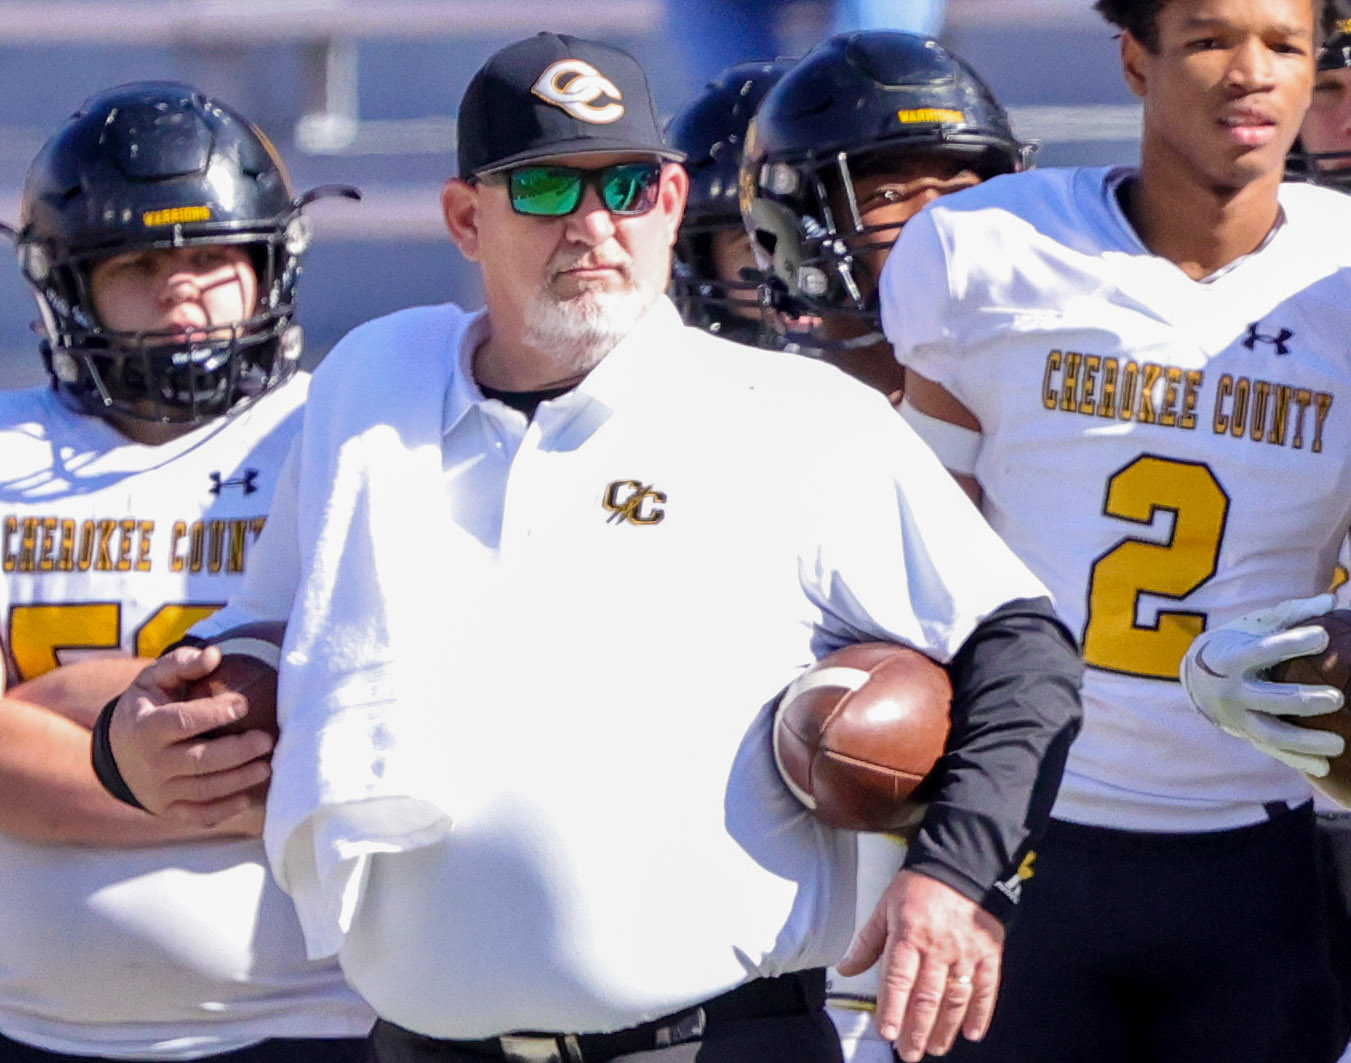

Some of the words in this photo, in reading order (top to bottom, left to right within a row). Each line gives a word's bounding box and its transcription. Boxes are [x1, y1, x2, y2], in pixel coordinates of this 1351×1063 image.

[1042, 350, 1204, 429] CHEROKEE
[1213, 374, 1334, 452] COUNTY
[3, 516, 154, 571] CHEROKEE
[1082, 453, 1231, 682] 2
